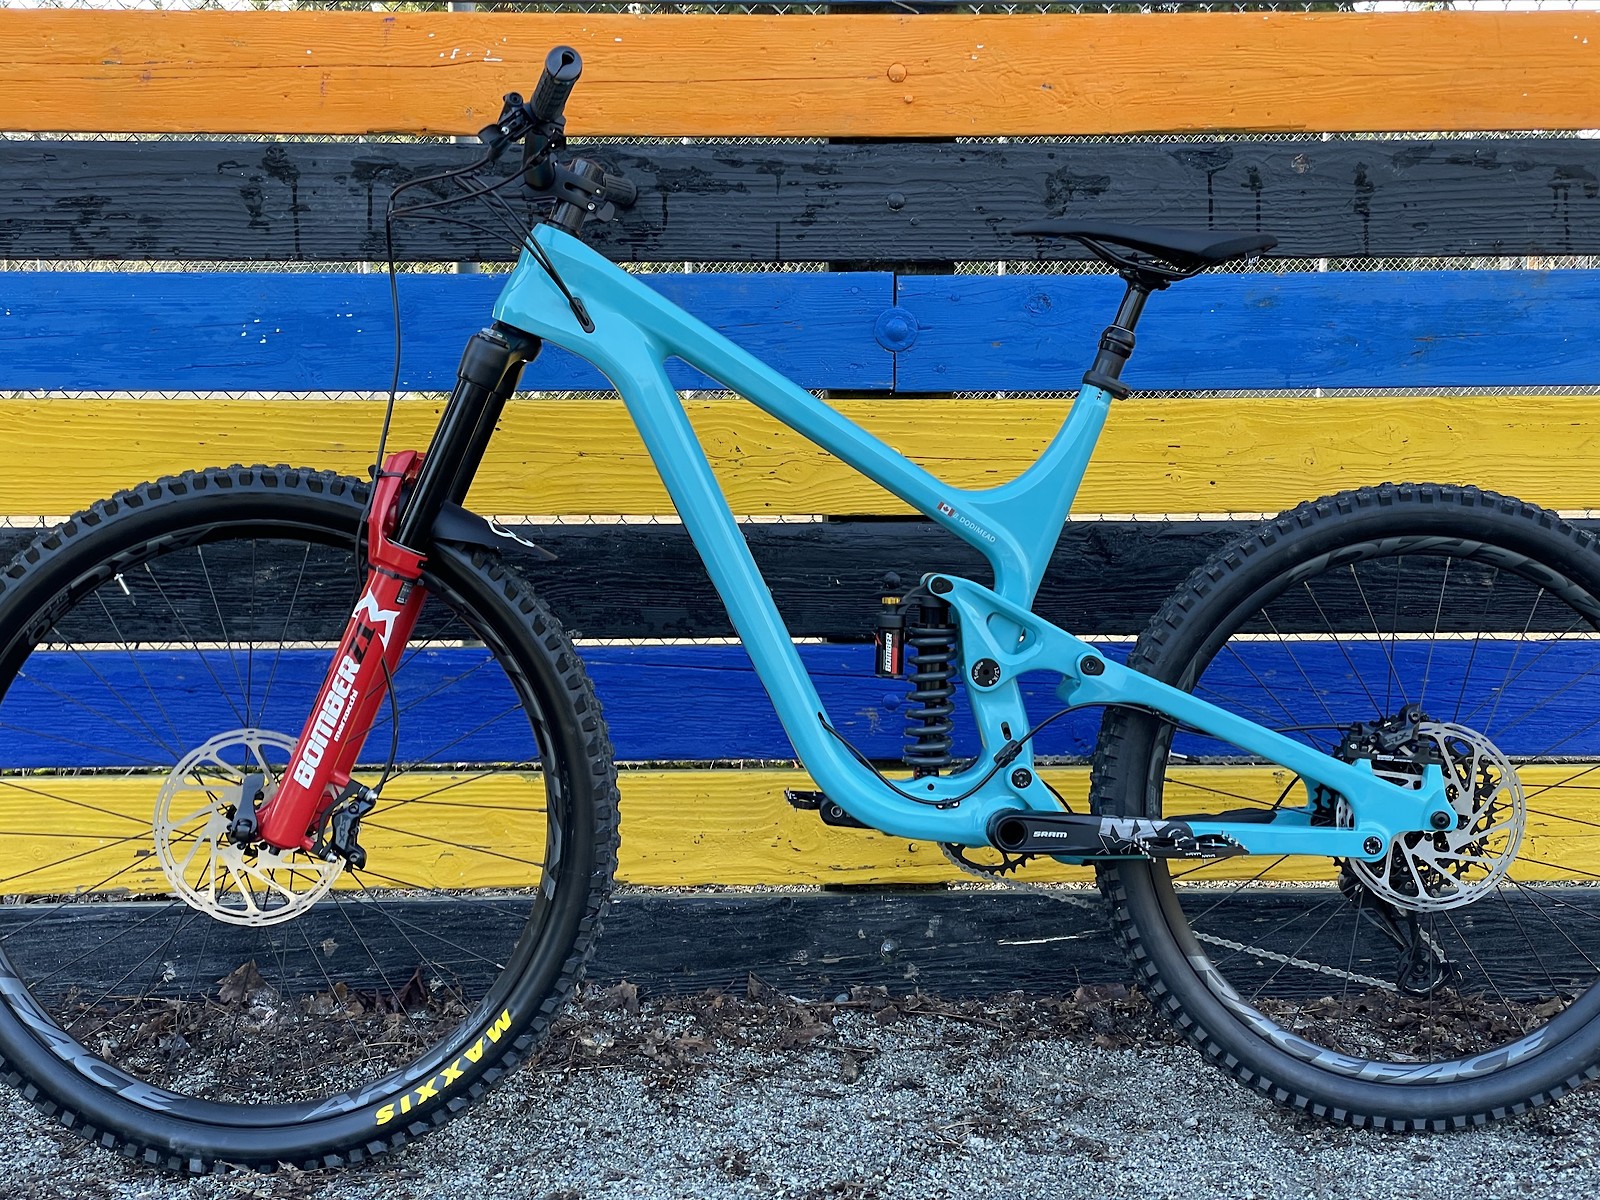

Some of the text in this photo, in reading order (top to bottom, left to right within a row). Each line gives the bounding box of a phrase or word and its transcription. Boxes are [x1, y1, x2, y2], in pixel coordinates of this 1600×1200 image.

[959, 516, 996, 543] DODIMEAD
[885, 632, 893, 673] BOMBER
[293, 655, 360, 790] BOMBER
[334, 690, 359, 742] marzocchi
[1032, 830, 1068, 839] SRAM
[375, 1008, 512, 1126] MAXXIS
